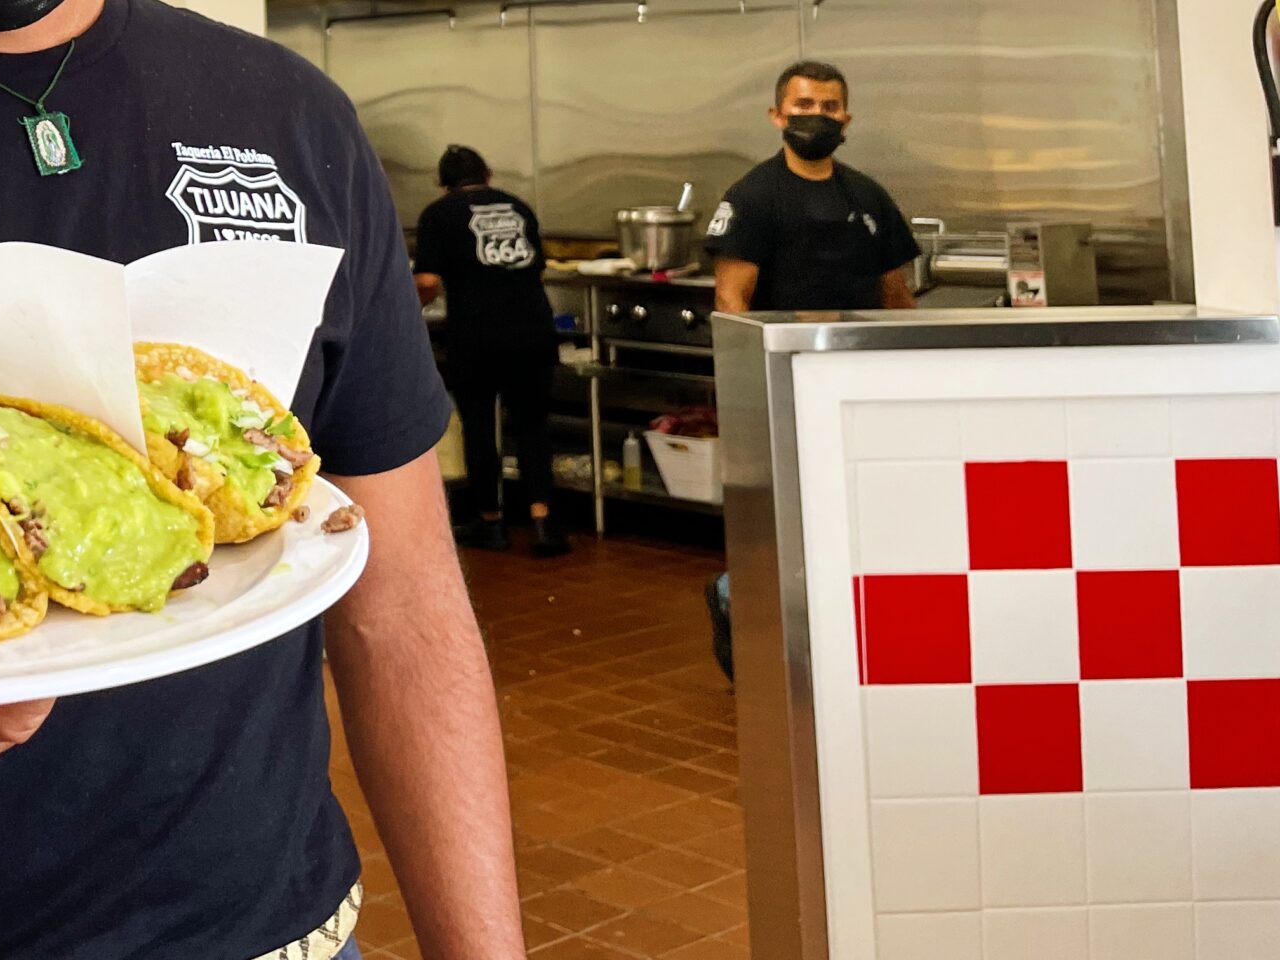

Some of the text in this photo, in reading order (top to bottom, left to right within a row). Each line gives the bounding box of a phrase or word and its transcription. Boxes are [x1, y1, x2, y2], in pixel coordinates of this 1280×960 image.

[171, 142, 222, 160] Taqueria
[220, 146, 234, 160] El
[187, 187, 293, 220] TIJUANA
[485, 235, 528, 264] 664
